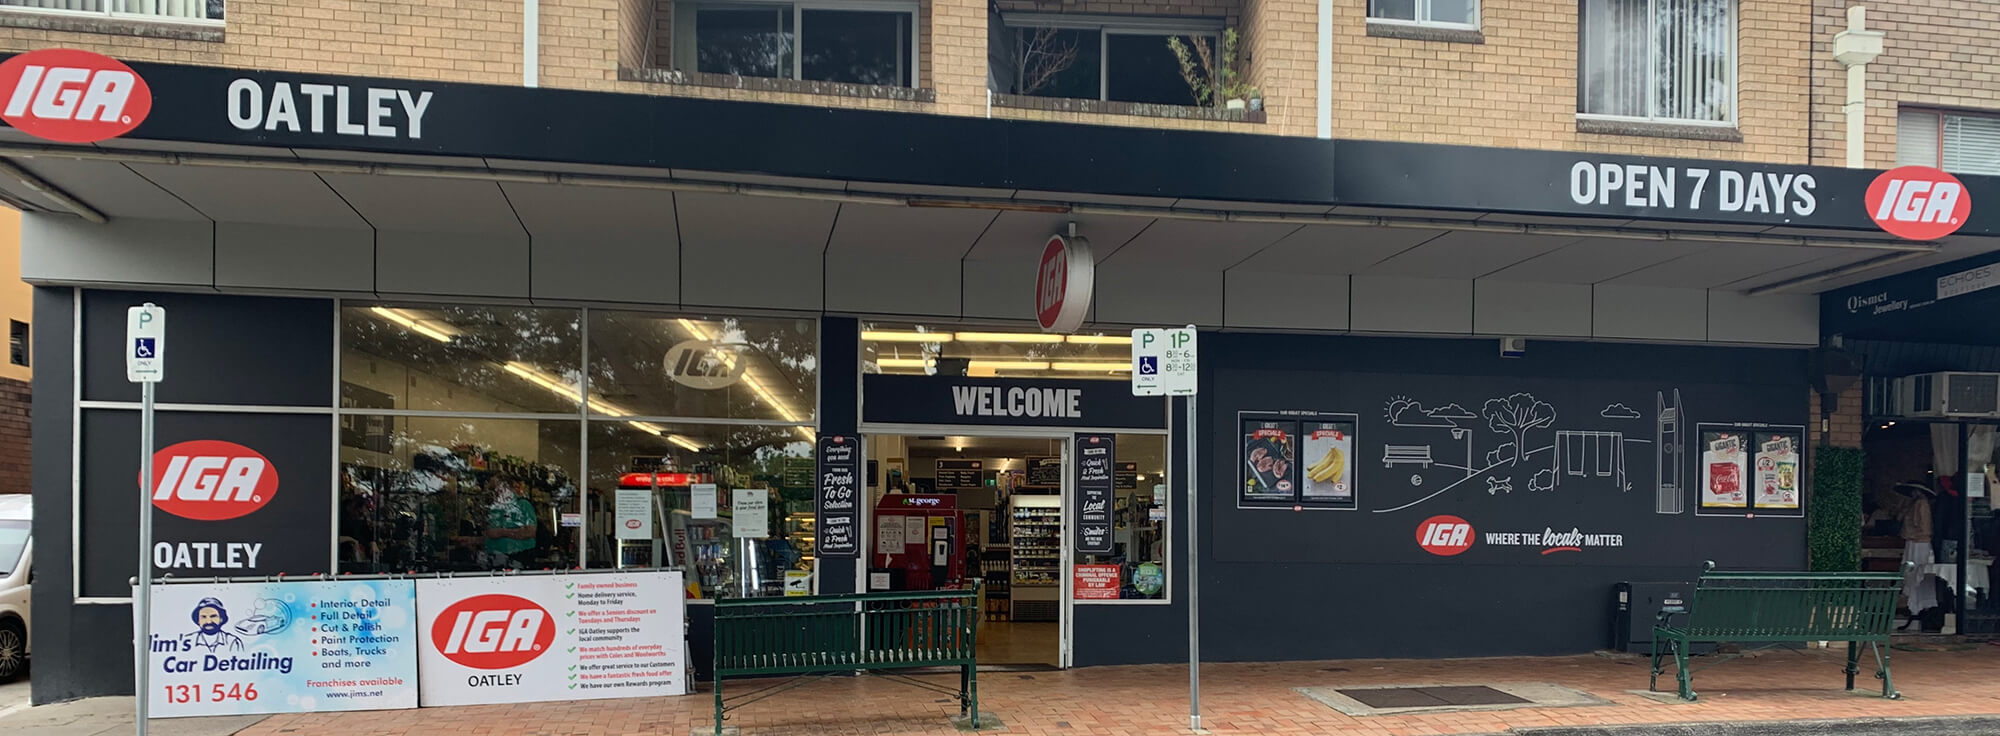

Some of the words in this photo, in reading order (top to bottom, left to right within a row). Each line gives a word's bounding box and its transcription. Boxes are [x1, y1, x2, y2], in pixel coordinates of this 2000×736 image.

[4, 65, 135, 122] IGA
[228, 78, 433, 139] OATLEY
[1570, 160, 1675, 208] OPEN
[1686, 168, 1710, 210] 7
[1719, 169, 1816, 216] DAYS
[1876, 179, 1961, 223] IGA
[1039, 248, 1065, 315] IGA
[1940, 267, 1991, 288] ECHOES
[139, 312, 152, 329] P
[1143, 333, 1154, 348] P
[1171, 333, 1190, 348] 1P
[952, 386, 1081, 417] WELCOME
[1086, 459, 1101, 467] Quick
[153, 455, 265, 501] IGA
[824, 472, 853, 485] Fresh
[823, 486, 836, 499] To
[837, 486, 852, 498] Go
[824, 500, 852, 509] Selection
[1083, 500, 1105, 511] Local
[674, 529, 685, 549] Bull
[1422, 523, 1470, 546] IGA
[1486, 533, 1519, 545] WHERE
[1522, 533, 1540, 545] THE
[1542, 527, 1582, 547] locals
[1585, 535, 1623, 546] MATTER
[154, 542, 262, 568] OATLEY
[320, 599, 357, 608] Interior
[361, 598, 390, 607] Detail
[321, 612, 338, 620] Full
[342, 611, 372, 619] Detail
[321, 624, 338, 632] Cut
[342, 624, 349, 632] &
[353, 623, 381, 631] Polish
[444, 609, 544, 654] IGA
[322, 635, 346, 644] Paint
[350, 634, 399, 643] Protection
[322, 648, 352, 656] Boats,
[355, 647, 386, 655] Trucks
[164, 656, 197, 673] Car
[203, 653, 292, 674] Detailing
[322, 660, 341, 668] and
[307, 678, 356, 688] Franchises
[360, 677, 403, 685] available
[468, 673, 522, 687] OATLEY
[165, 684, 200, 703] 131
[212, 683, 258, 702] 546
[327, 690, 383, 698] www.jims.net
